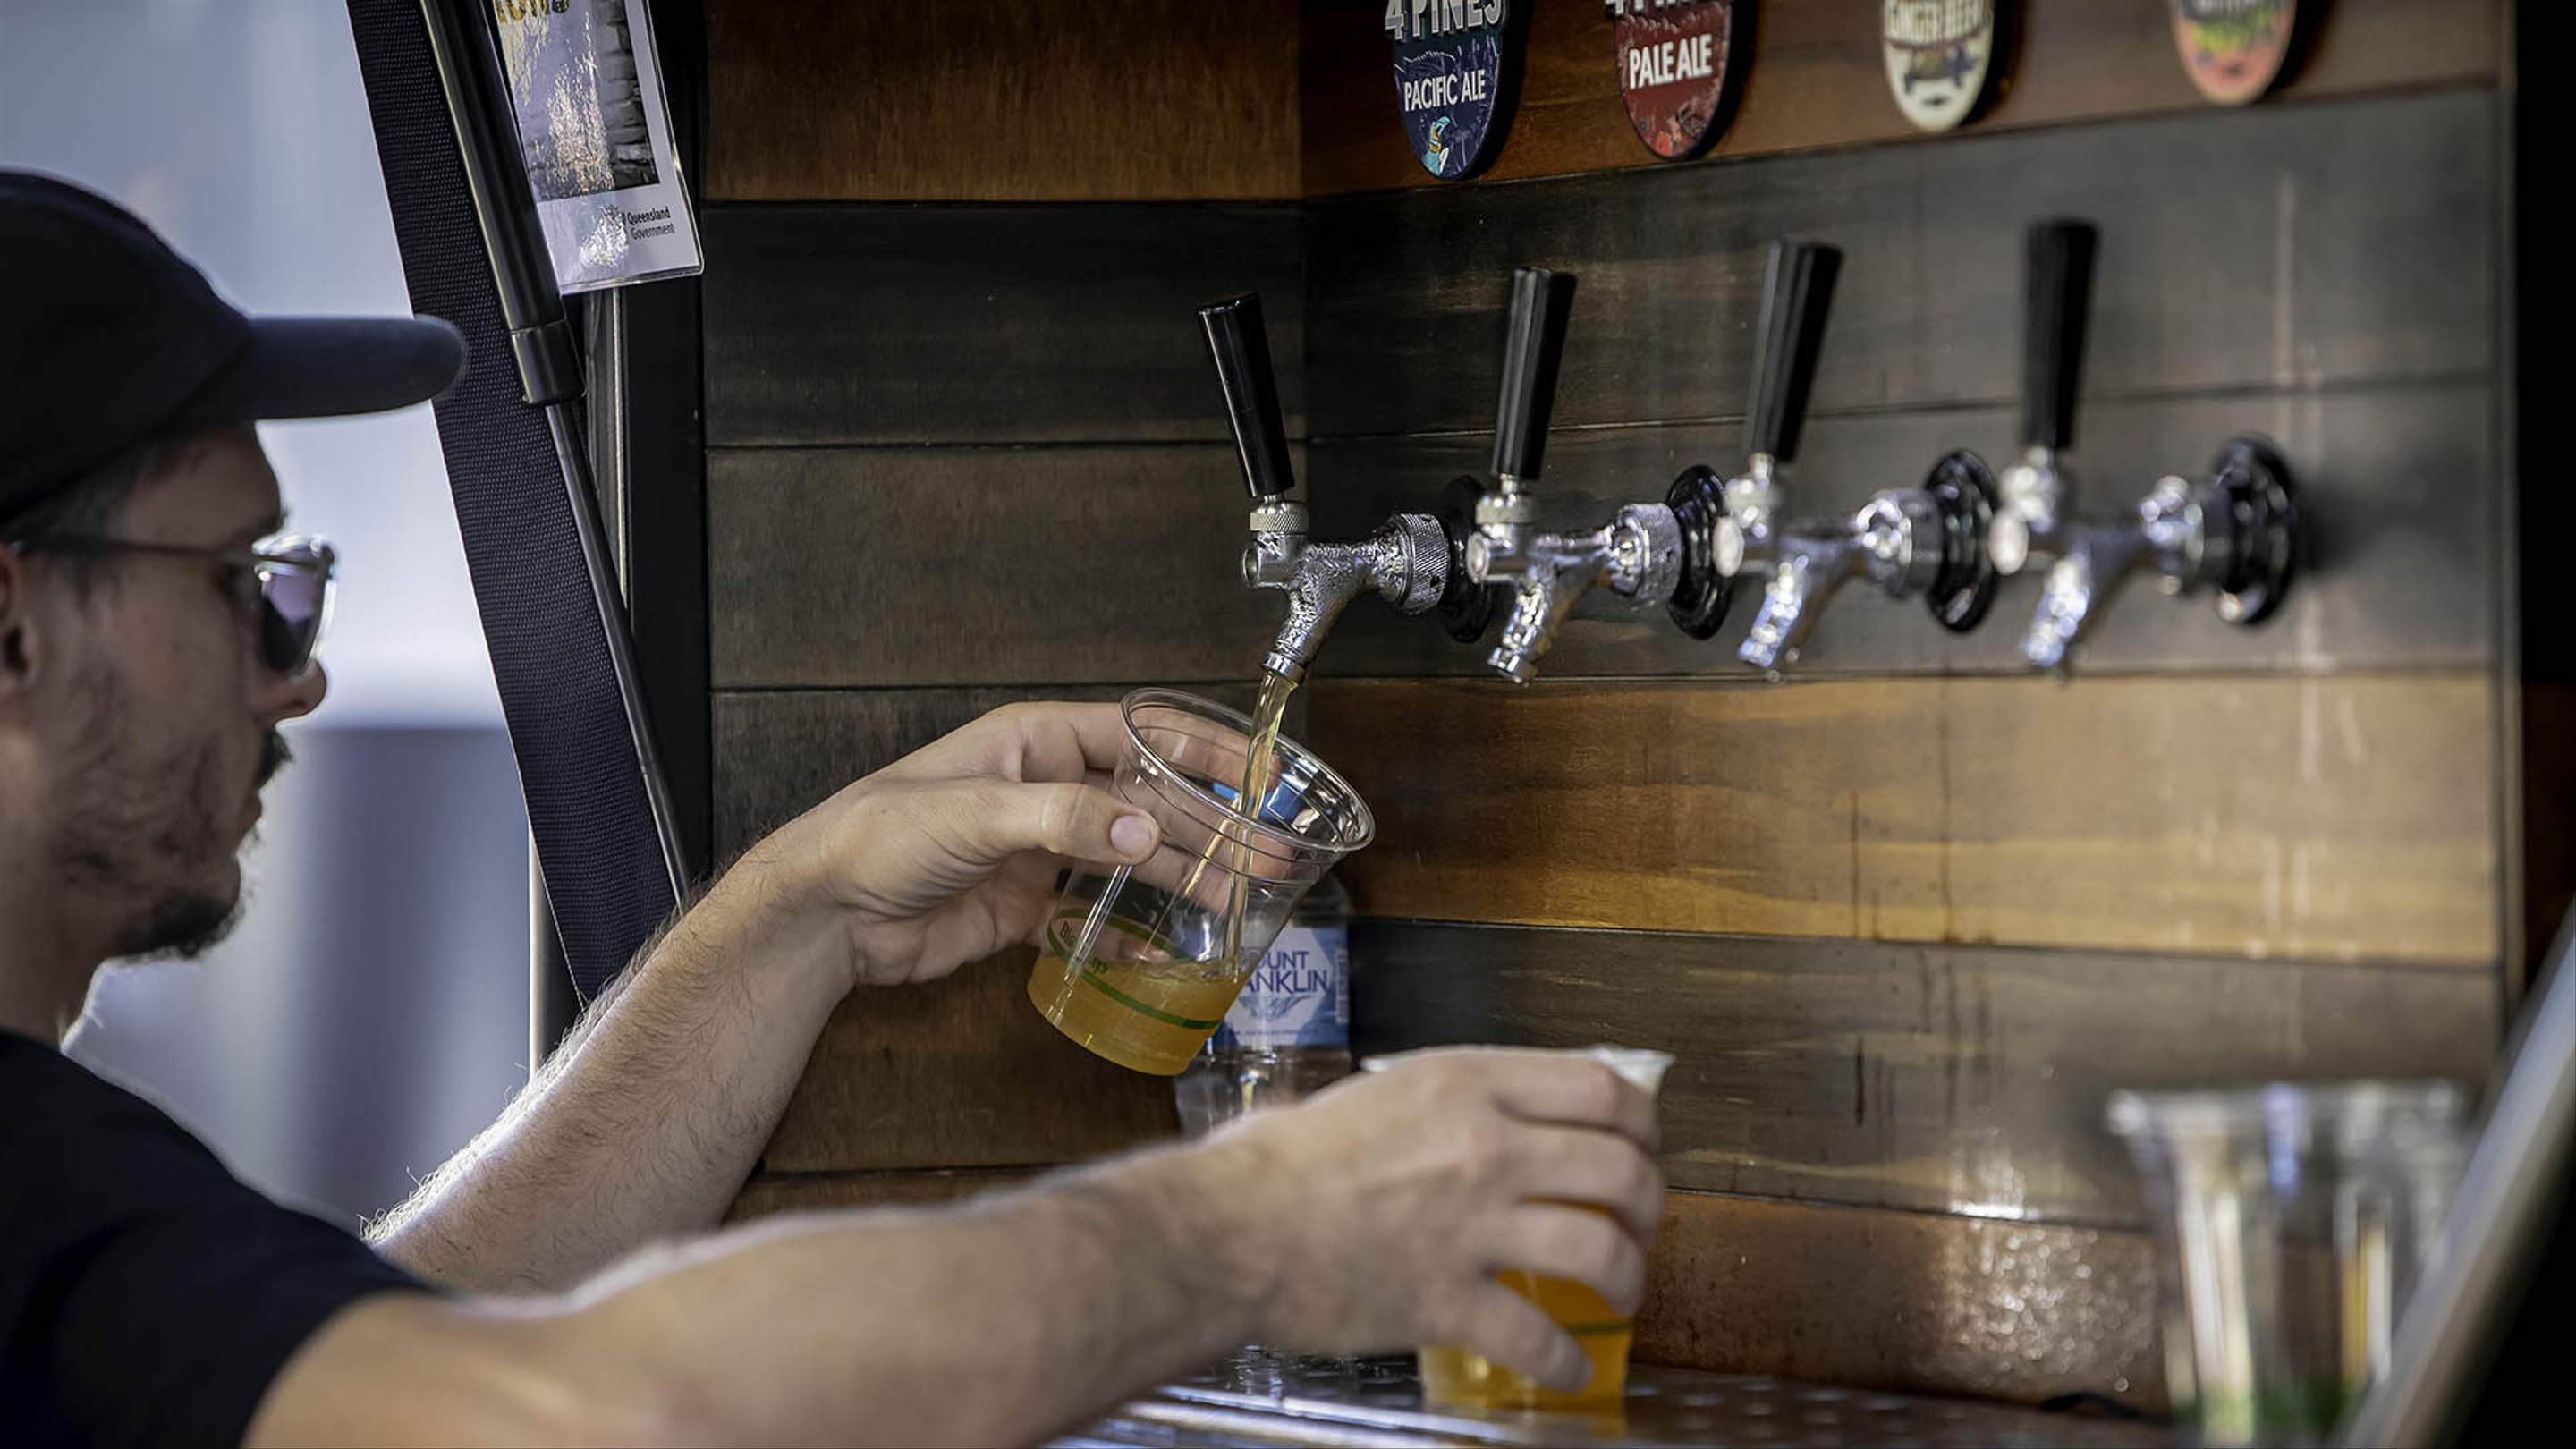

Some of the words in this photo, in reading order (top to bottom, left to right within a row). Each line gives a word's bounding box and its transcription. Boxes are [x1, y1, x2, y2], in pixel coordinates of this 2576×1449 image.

[1385, 0, 1404, 40] 4
[1412, 0, 1502, 37] PINES
[1629, 41, 1674, 90] PALE
[1675, 33, 1713, 81] ALE
[1404, 73, 1459, 112] PACIFIC
[1461, 69, 1486, 103] ALE
[627, 206, 671, 225] Queensland
[631, 223, 675, 240] Government
[1256, 950, 1309, 970] UNT
[1246, 969, 1329, 995] NKLIN
